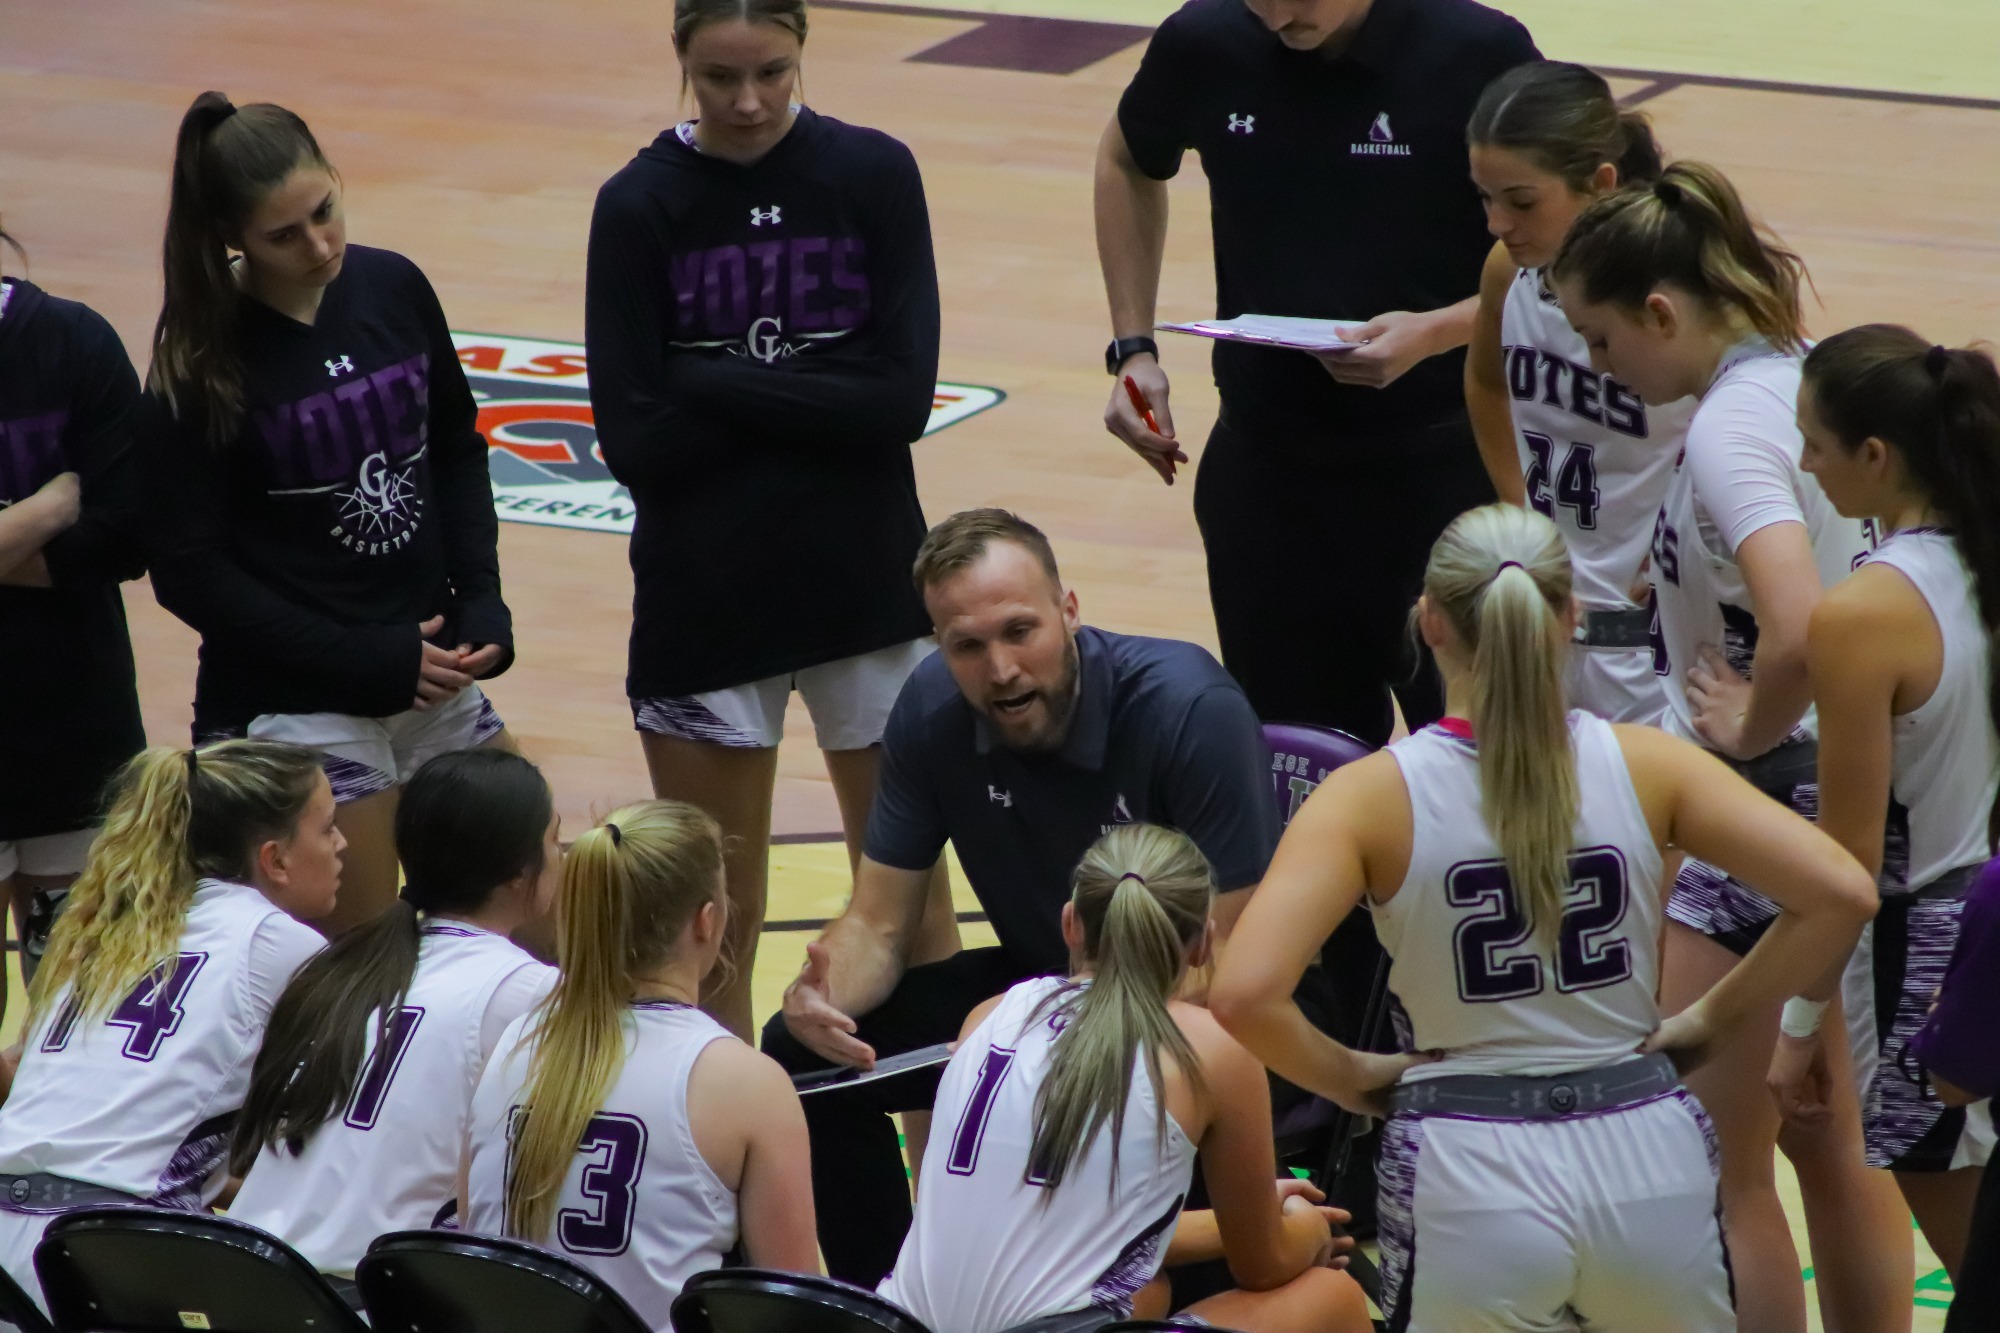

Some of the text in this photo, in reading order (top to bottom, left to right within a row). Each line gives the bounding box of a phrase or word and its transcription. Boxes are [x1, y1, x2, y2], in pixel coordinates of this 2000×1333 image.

[1351, 143, 1411, 155] BASKETBALL
[670, 236, 871, 335] YOTES
[1501, 345, 1648, 439] OTES
[329, 499, 424, 556] BASKETBALL
[1522, 430, 1600, 531] 24
[1444, 845, 1633, 1003] 22
[501, 1105, 648, 1257] 3
